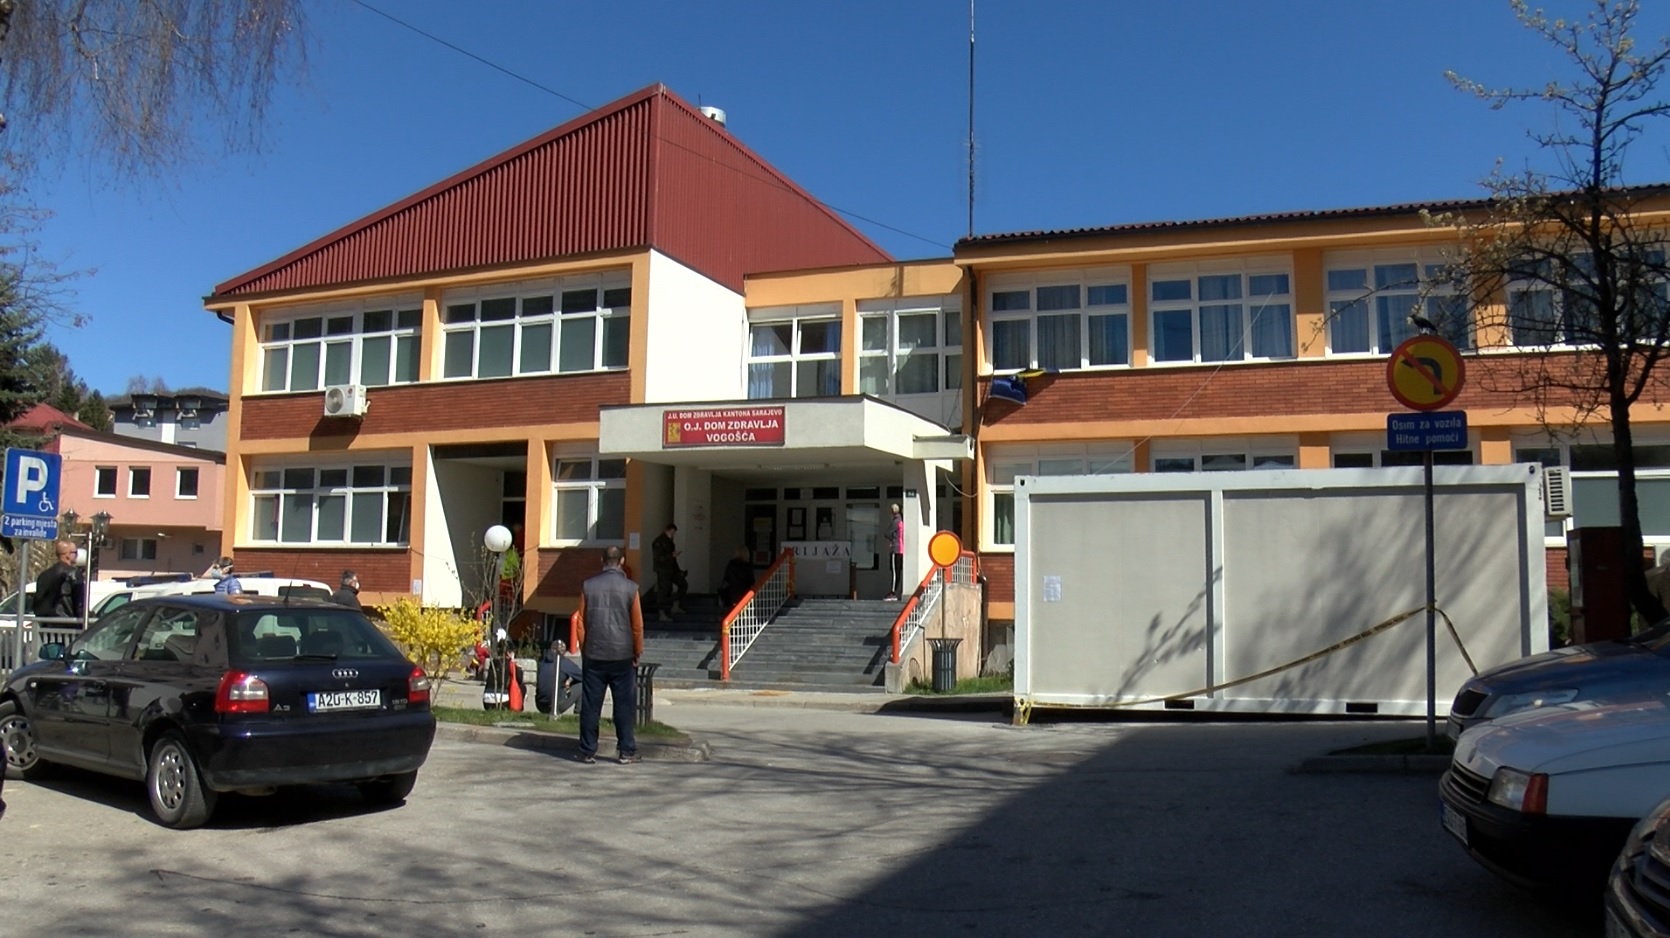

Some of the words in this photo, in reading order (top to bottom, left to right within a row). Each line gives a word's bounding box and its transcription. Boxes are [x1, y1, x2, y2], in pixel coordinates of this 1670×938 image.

[693, 411, 722, 419] ZDRAVLJA
[723, 410, 751, 418] KANTONA
[752, 408, 783, 417] SARAJEVO
[684, 422, 702, 431] O.J.
[704, 421, 726, 431] DOM
[727, 419, 779, 430] ZDRAVLJA
[1392, 420, 1415, 430] Osim
[1420, 420, 1430, 430] za
[1434, 417, 1462, 428] vozila
[706, 430, 756, 442] VOGOŠĆA
[1396, 433, 1420, 444] Hitne
[16, 455, 48, 504] P
[4, 516, 10, 526] 2
[10, 517, 35, 530] parking
[35, 519, 57, 531] mjesta
[14, 528, 22, 536] za
[23, 527, 47, 538] invalide
[783, 544, 850, 556] RIJAŽA
[274, 703, 291, 711] A3
